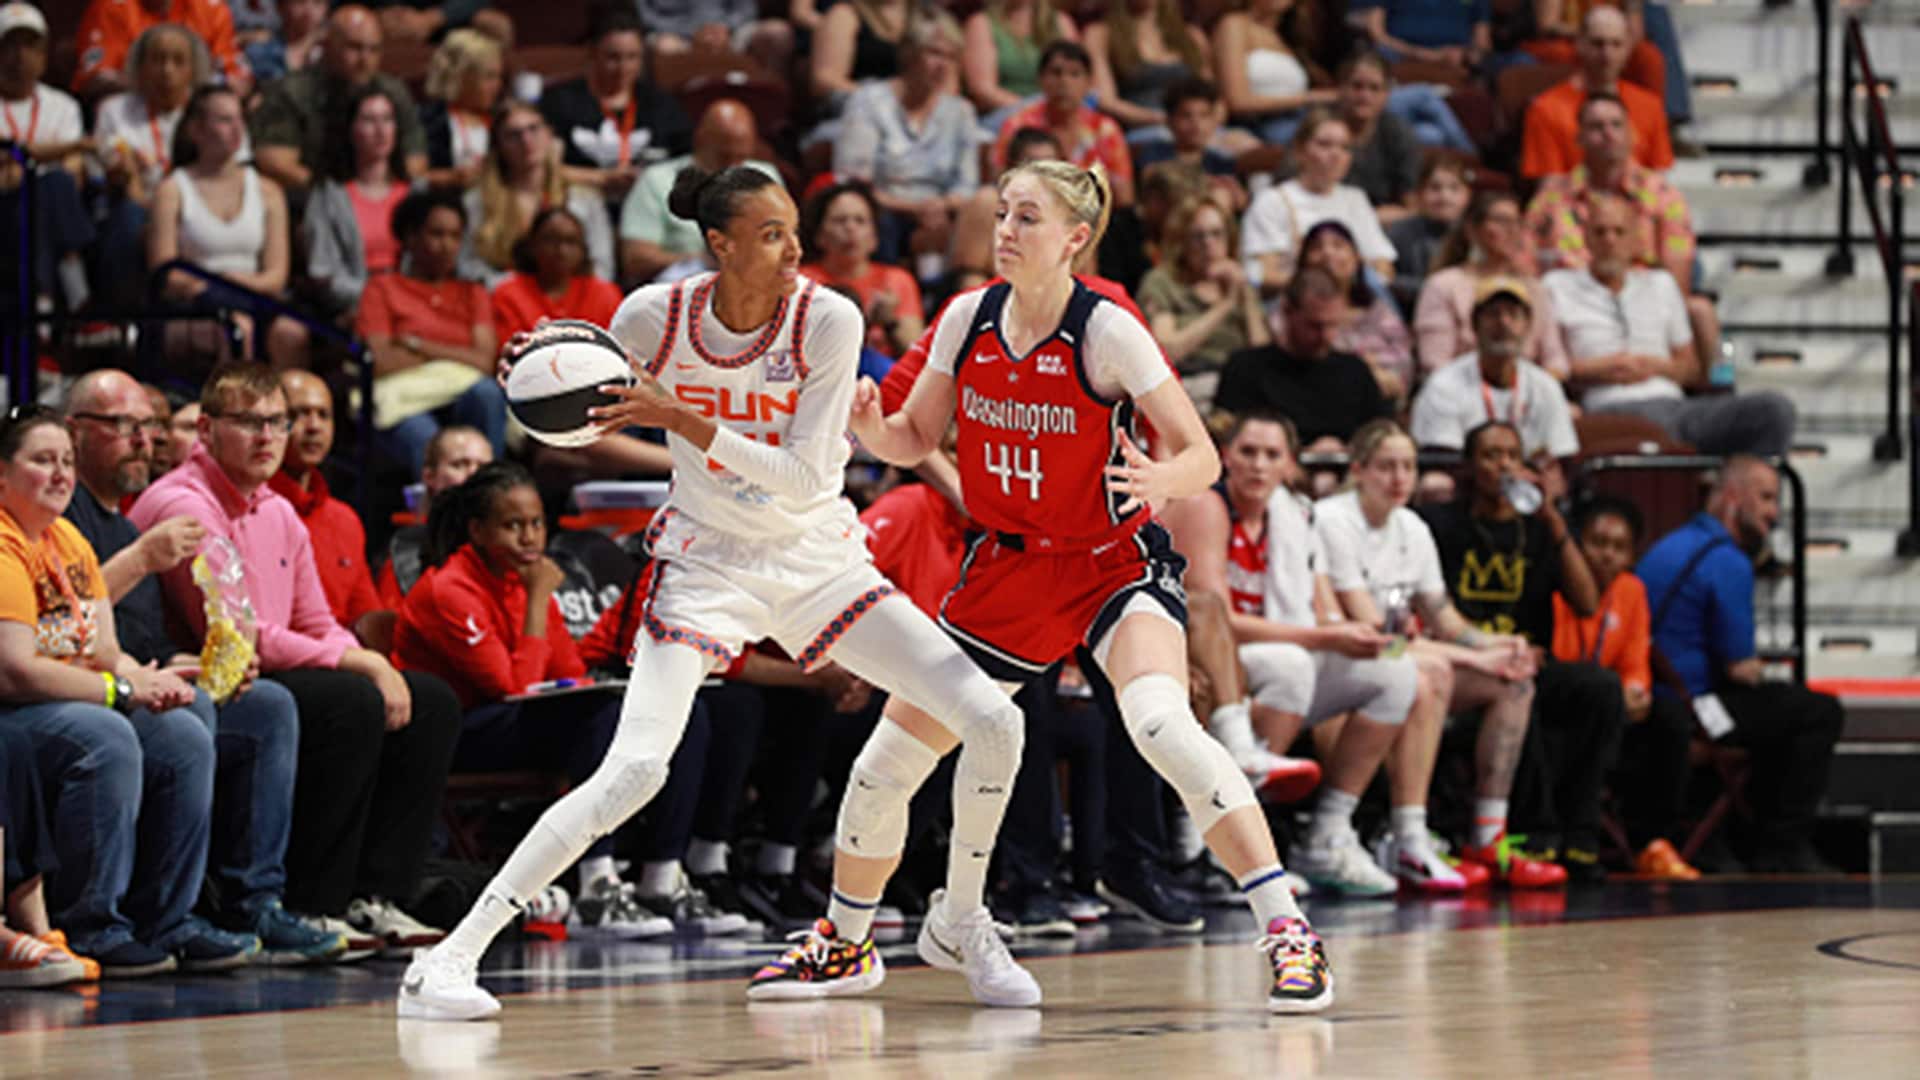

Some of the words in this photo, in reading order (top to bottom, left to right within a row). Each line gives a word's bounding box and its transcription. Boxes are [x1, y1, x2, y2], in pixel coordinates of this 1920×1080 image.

[675, 384, 798, 421] SUN
[962, 386, 1077, 440] Washington
[984, 442, 1044, 500] 44
